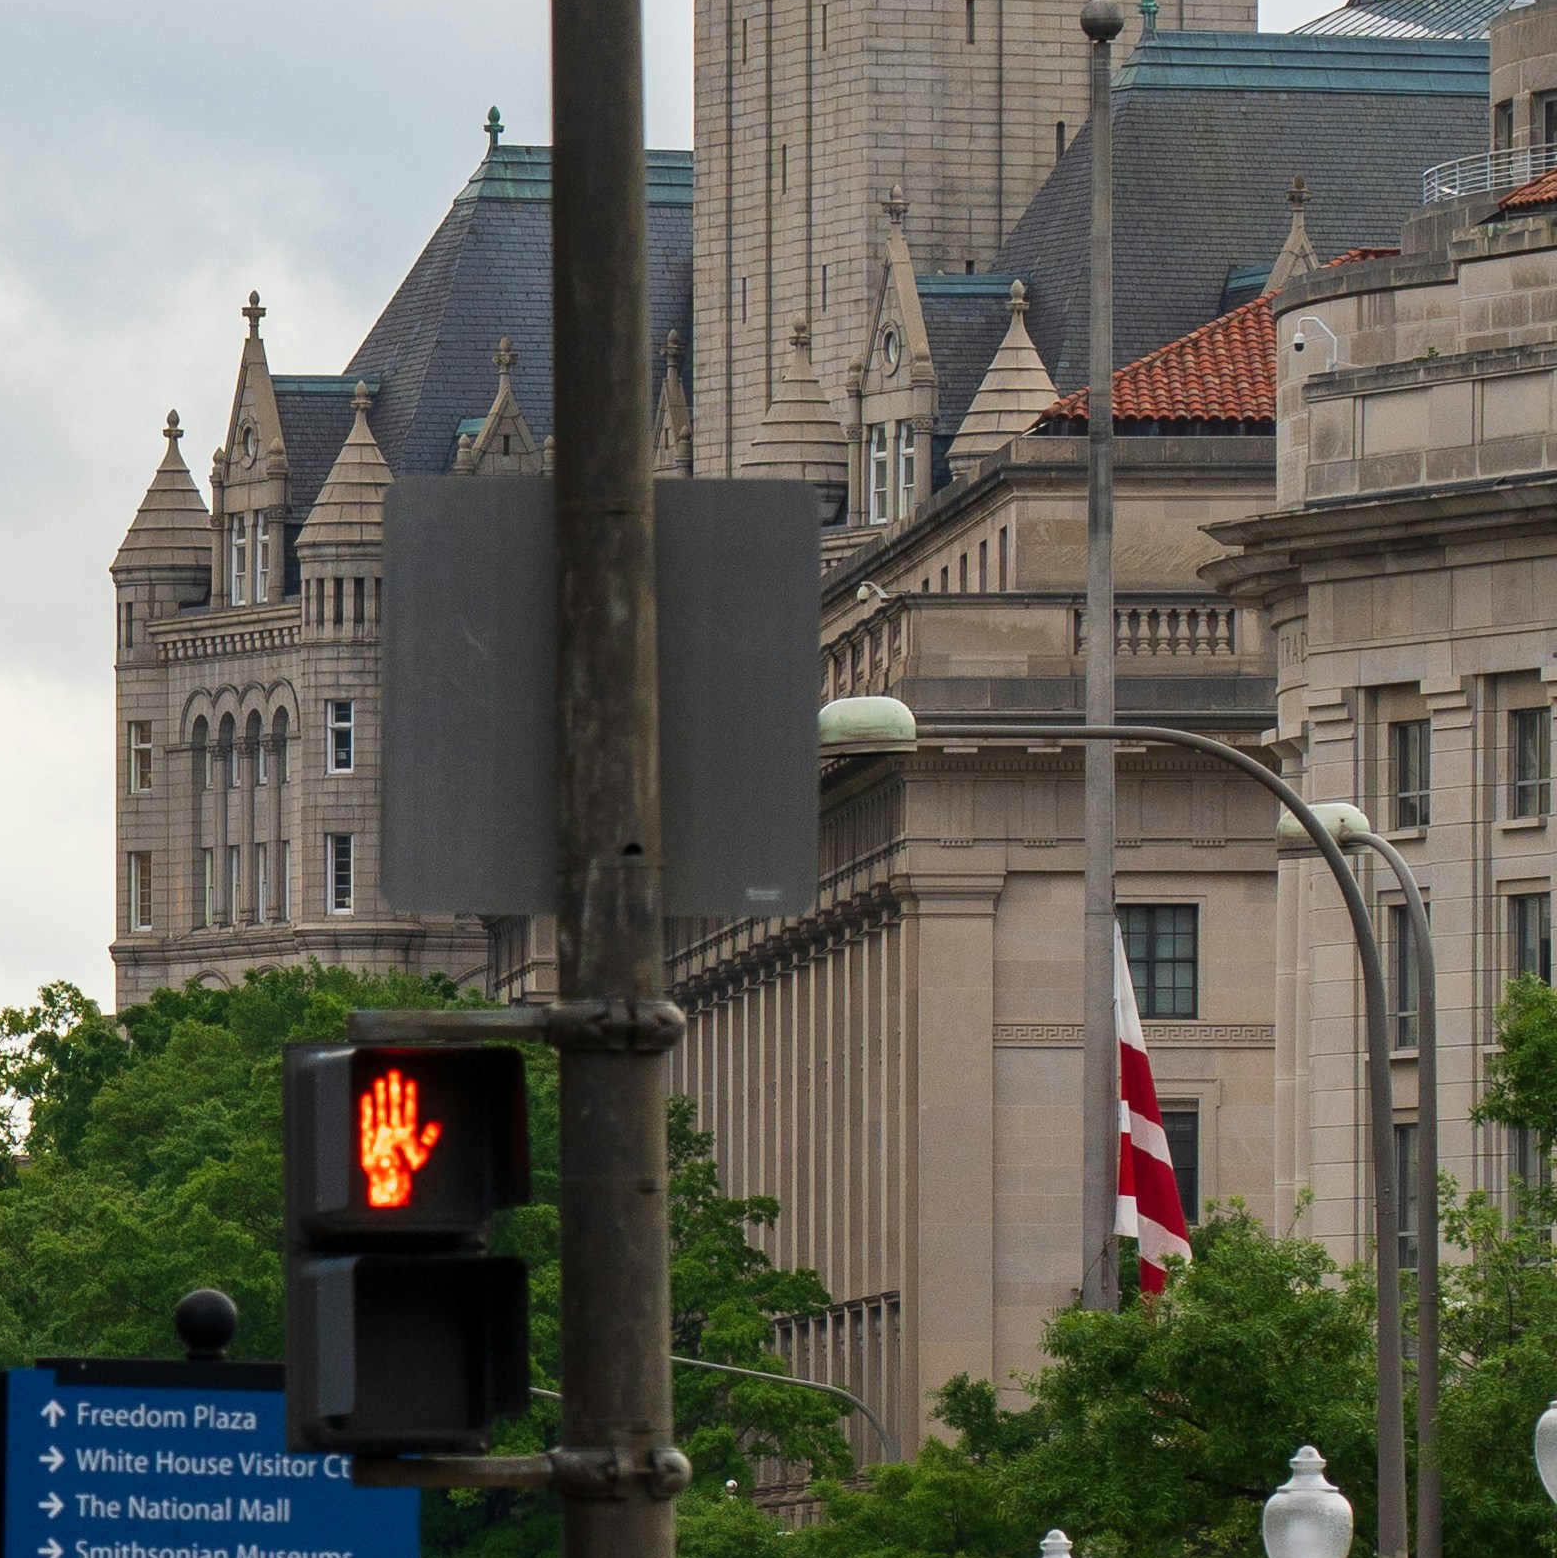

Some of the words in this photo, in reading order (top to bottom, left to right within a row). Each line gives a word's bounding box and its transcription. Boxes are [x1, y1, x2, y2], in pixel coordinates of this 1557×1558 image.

[77, 1402, 186, 1429] Freedom
[193, 1404, 257, 1431] Plaza
[76, 1447, 148, 1474] White
[155, 1449, 233, 1475] House
[239, 1452, 317, 1477] Visitor
[323, 1454, 351, 1479] Ct
[75, 1494, 121, 1520] The
[128, 1496, 232, 1522] National
[239, 1498, 291, 1522] Mall
